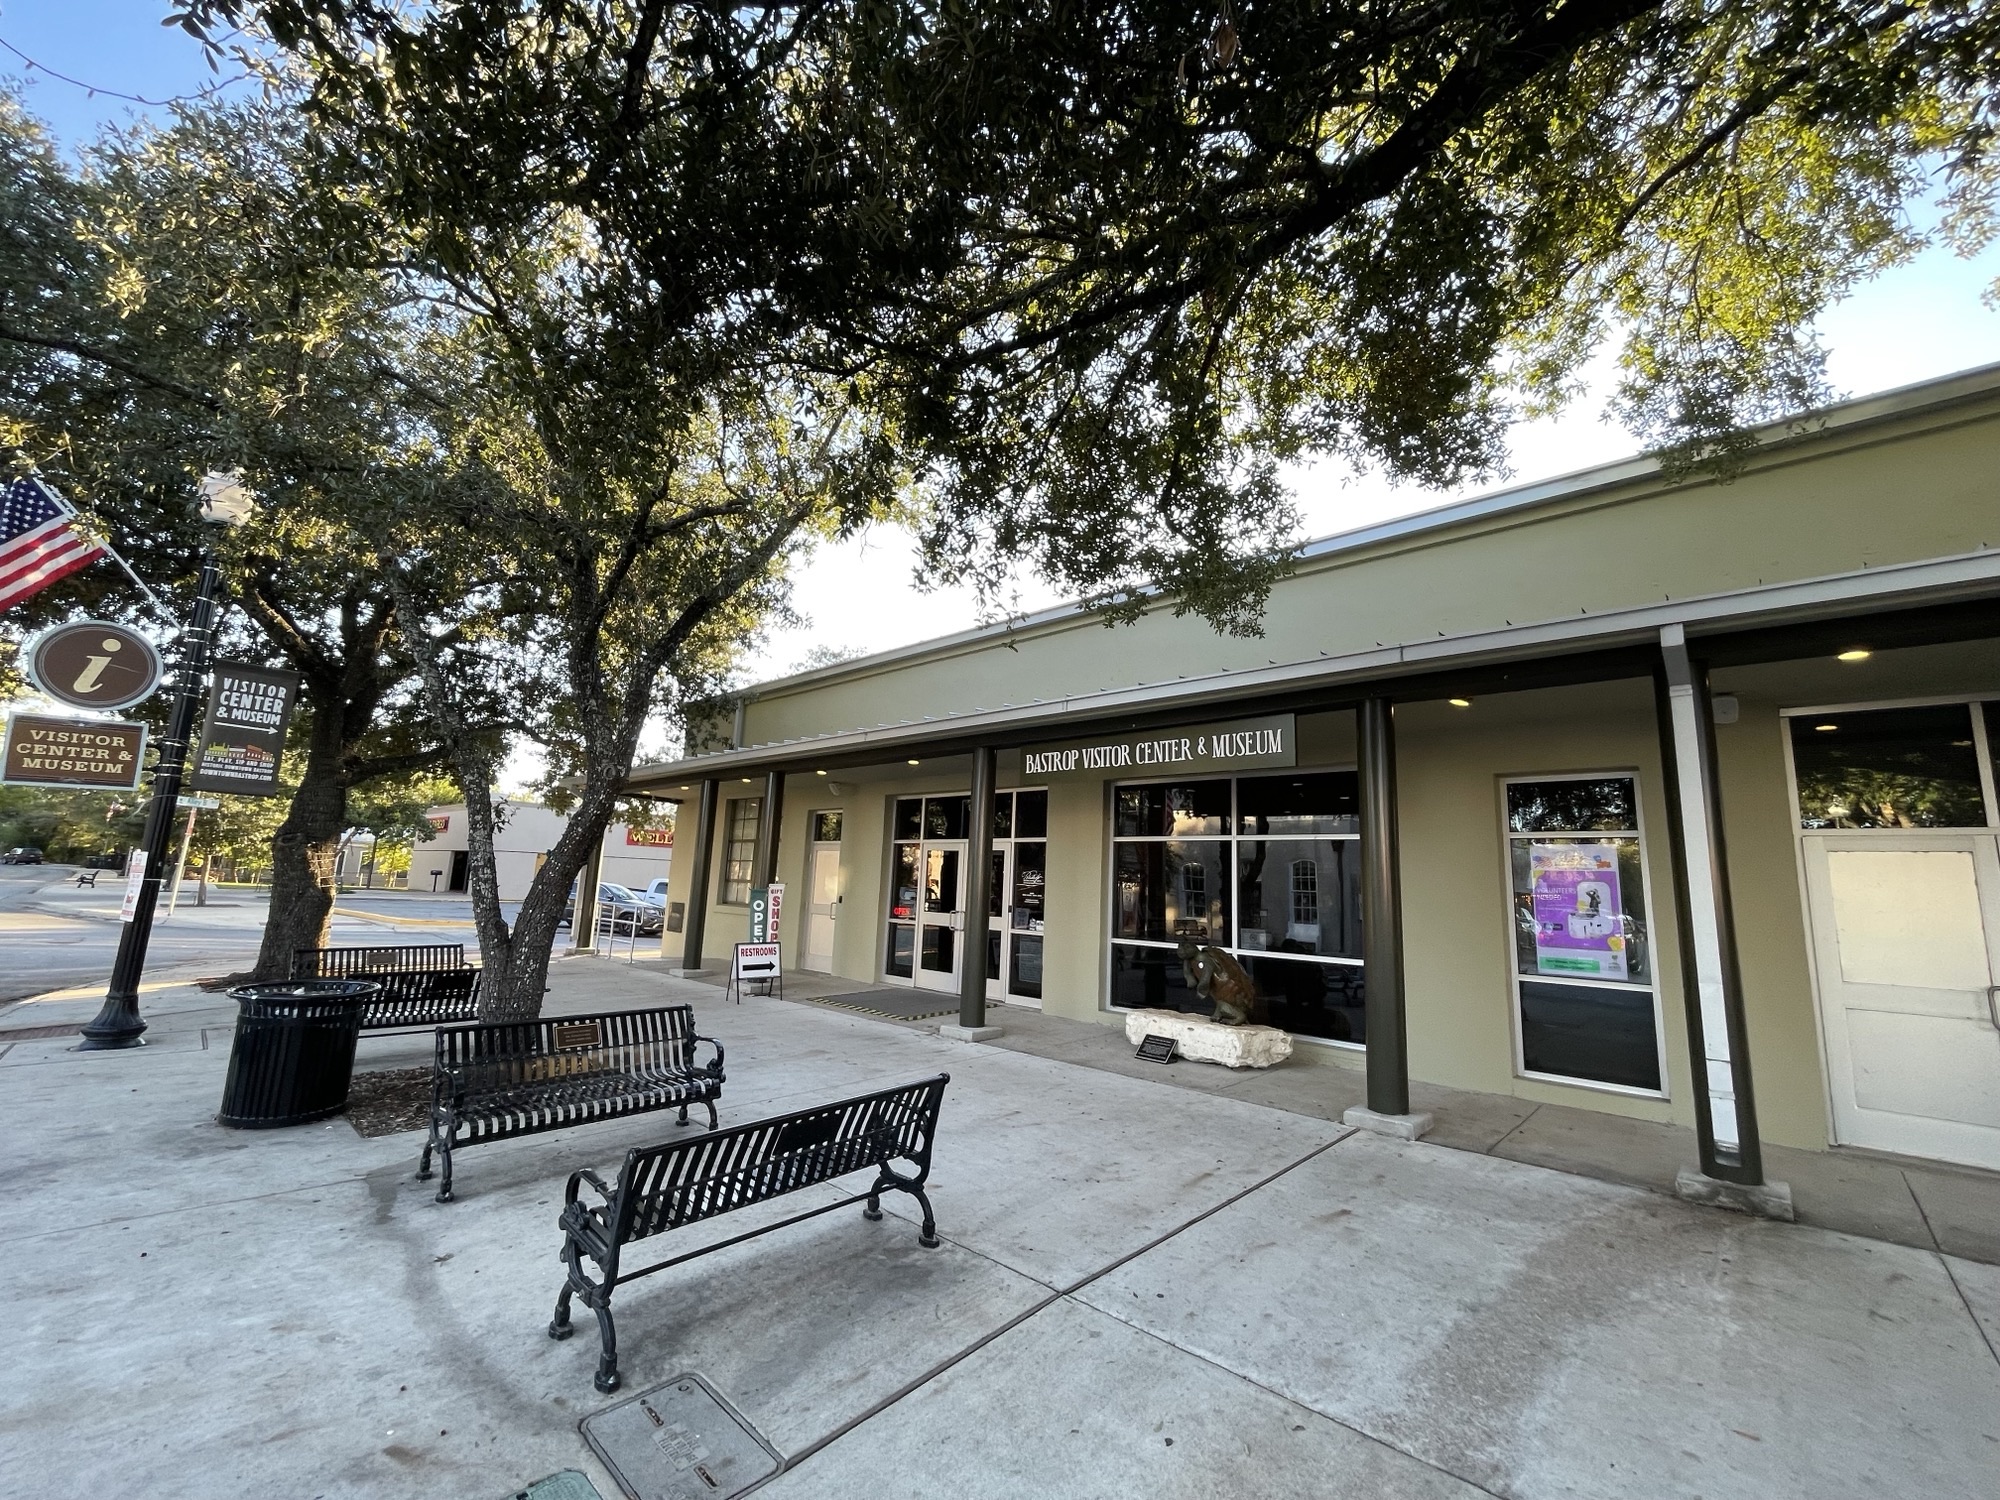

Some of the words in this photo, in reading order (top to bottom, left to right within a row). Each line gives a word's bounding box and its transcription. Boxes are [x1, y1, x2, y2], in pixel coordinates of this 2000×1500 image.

[223, 677, 287, 699] VISITOR
[220, 690, 284, 714] CENTER
[216, 706, 229, 718] &
[231, 708, 282, 726] MUSEUM
[30, 729, 126, 748] VISITOR
[16, 743, 118, 761] CENTER
[118, 749, 133, 762] &
[1025, 751, 1079, 774] BASTROP
[1082, 744, 1132, 769] VISITOR
[1135, 737, 1194, 765] CENTER
[1197, 735, 1208, 756] &
[1211, 728, 1283, 759] MUSEUM
[22, 757, 125, 774] MUSEUM
[770, 895, 781, 943] SHOP
[740, 946, 777, 958] RESTROOMS
